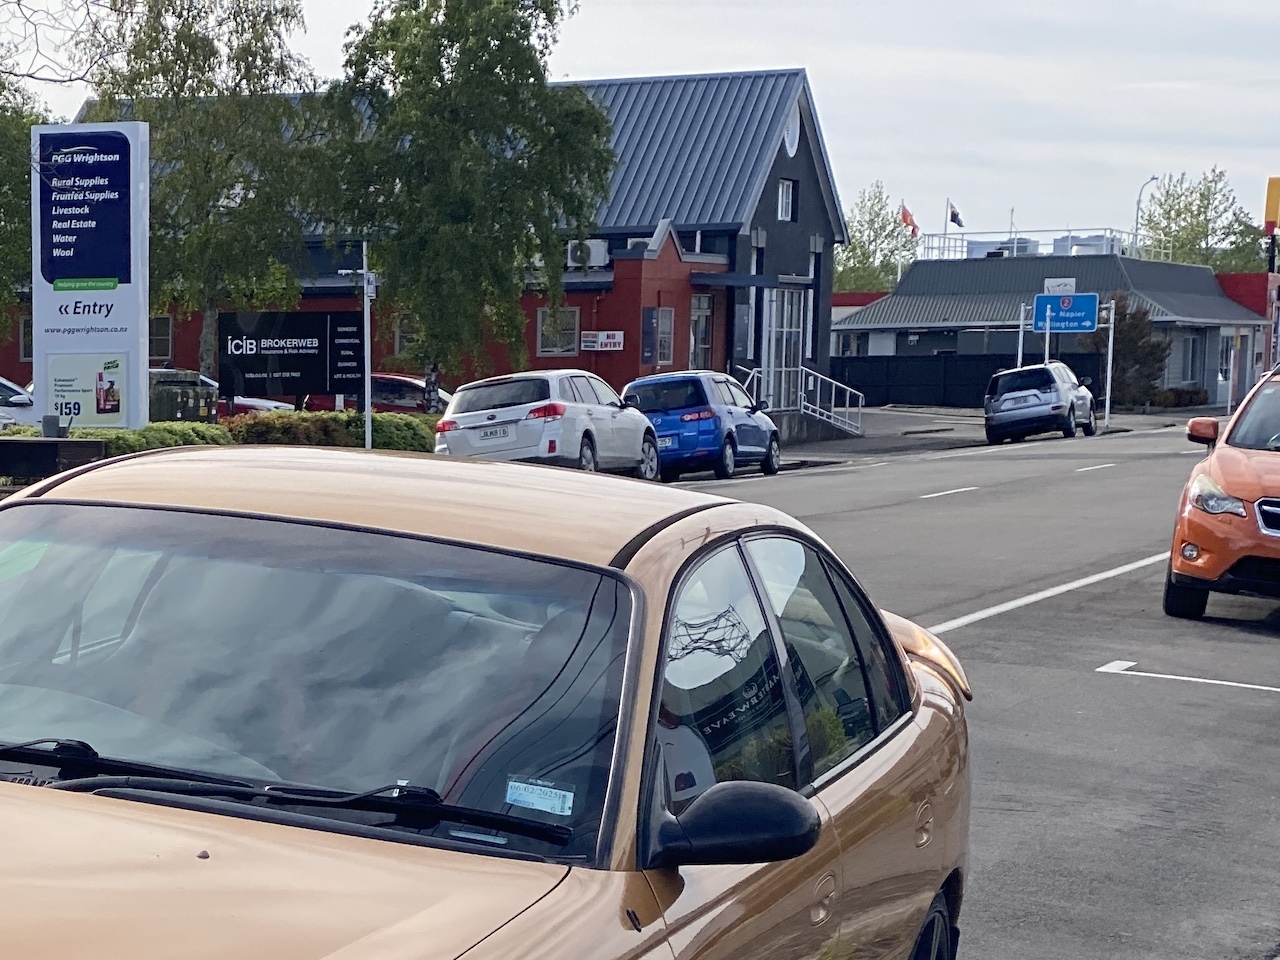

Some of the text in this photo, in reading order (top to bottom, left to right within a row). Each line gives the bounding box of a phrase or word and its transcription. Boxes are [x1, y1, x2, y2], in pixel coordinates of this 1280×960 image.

[51, 153, 120, 164] PGG Wrightson
[51, 176, 109, 187] Rural Supplies
[84, 190, 119, 202] Supplies
[51, 205, 90, 215] Livestock
[51, 219, 97, 229] Real Estate
[52, 234, 77, 243] Water
[52, 248, 74, 257] Wool
[73, 300, 114, 318] Entry
[1059, 310, 1086, 319] Napier
[44, 325, 128, 335] www.pggwrightson.co.nz
[606, 332, 616, 340] NO
[260, 338, 319, 348] BROKERWEB
[600, 341, 622, 349] ENTRY
[54, 401, 81, 416] $159
